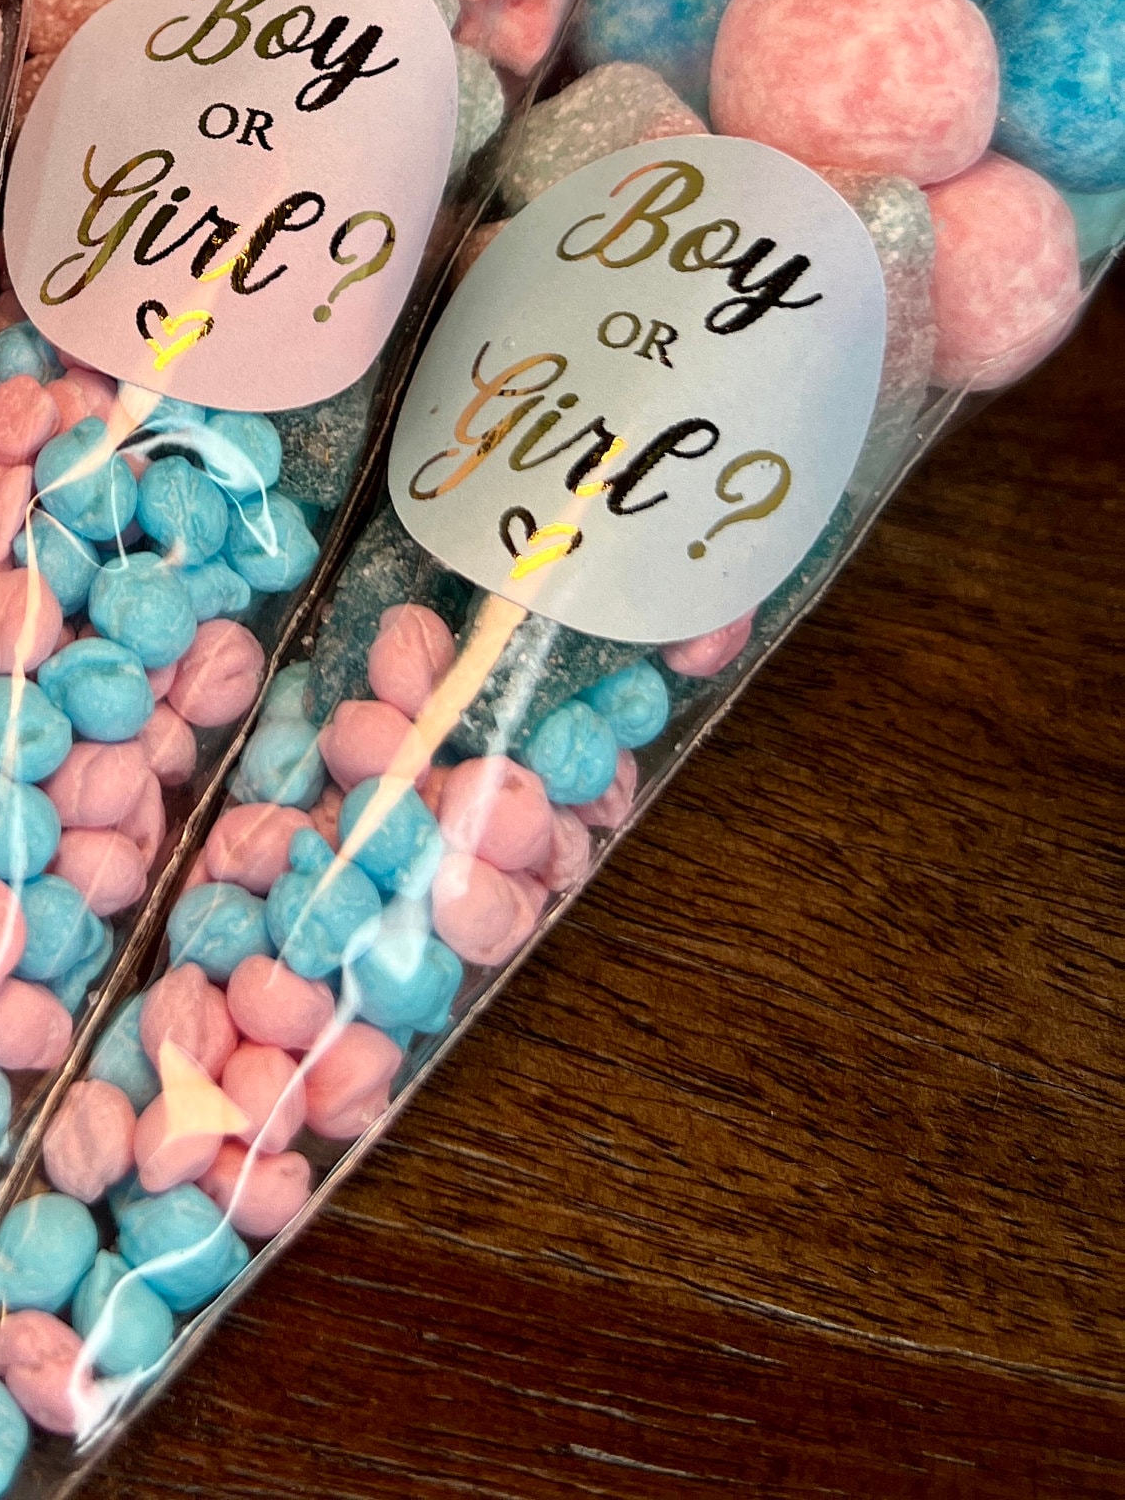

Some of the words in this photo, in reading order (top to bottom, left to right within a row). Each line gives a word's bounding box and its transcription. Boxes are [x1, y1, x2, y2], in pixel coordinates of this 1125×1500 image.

[198, 102, 274, 151] OR
[39, 145, 396, 323] Girl?
[556, 160, 823, 334] Boy
[597, 311, 678, 369] OR
[409, 341, 792, 560] Girl?
